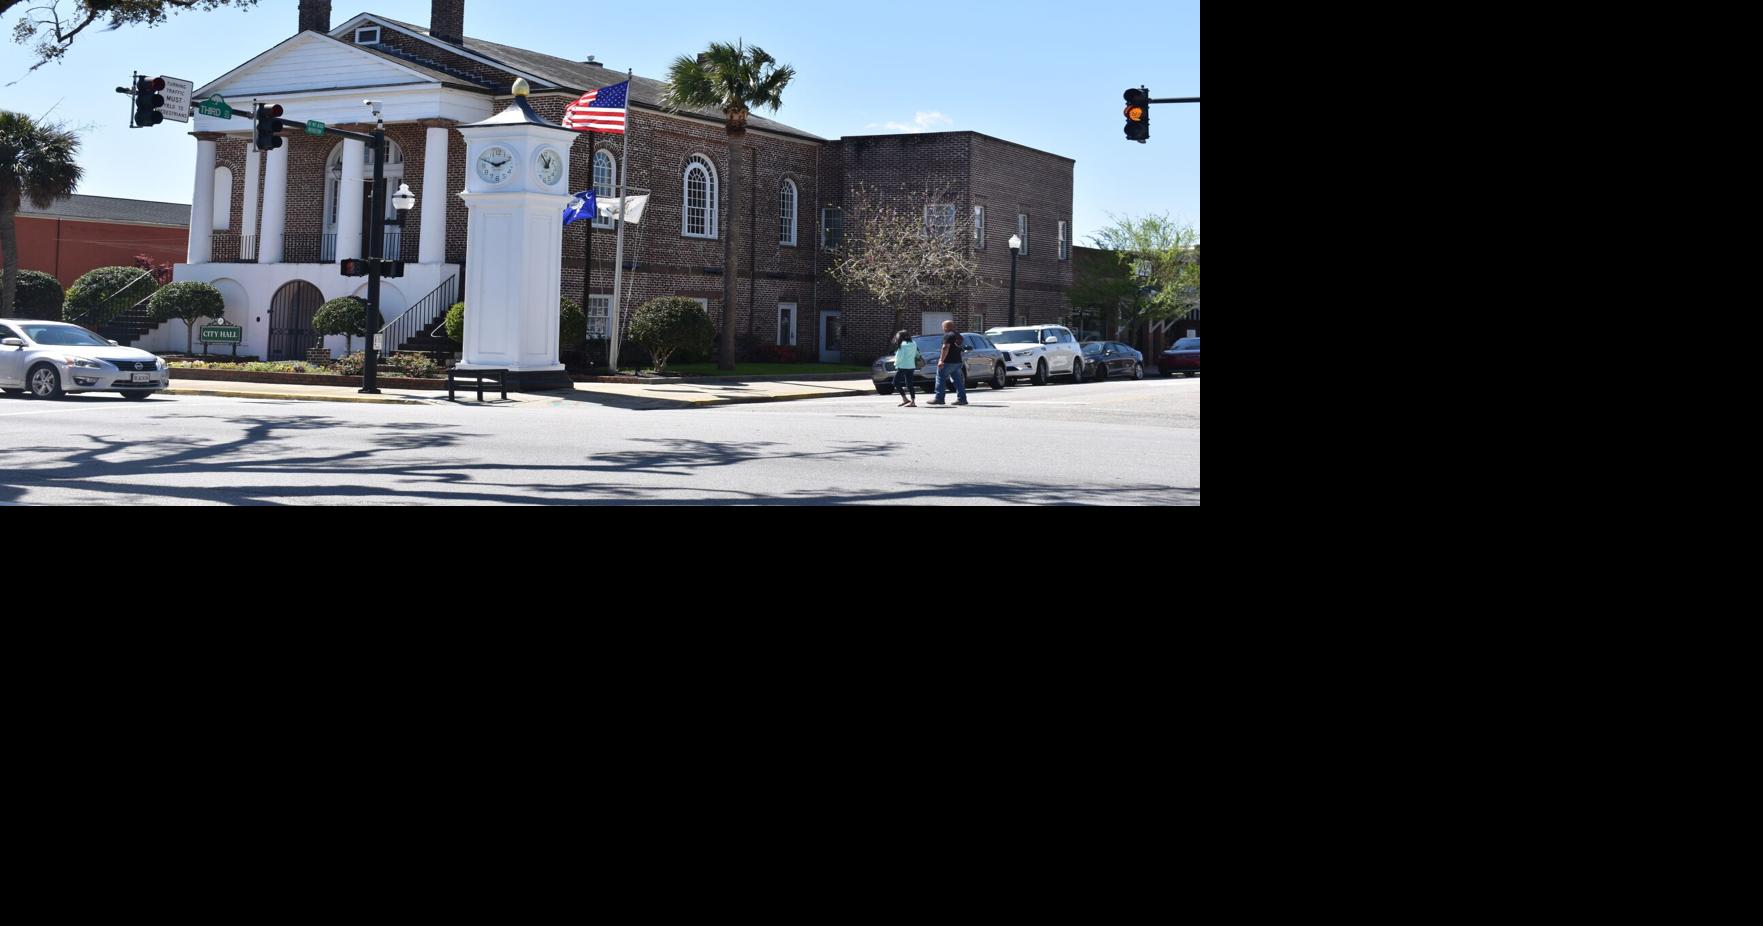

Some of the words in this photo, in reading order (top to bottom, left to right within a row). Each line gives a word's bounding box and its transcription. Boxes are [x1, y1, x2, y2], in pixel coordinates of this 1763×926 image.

[167, 81, 186, 89] TURNING
[166, 88, 185, 96] TRAFFIC
[166, 95, 182, 103] MUST
[200, 105, 221, 117] THIRD
[203, 330, 219, 338] CITY
